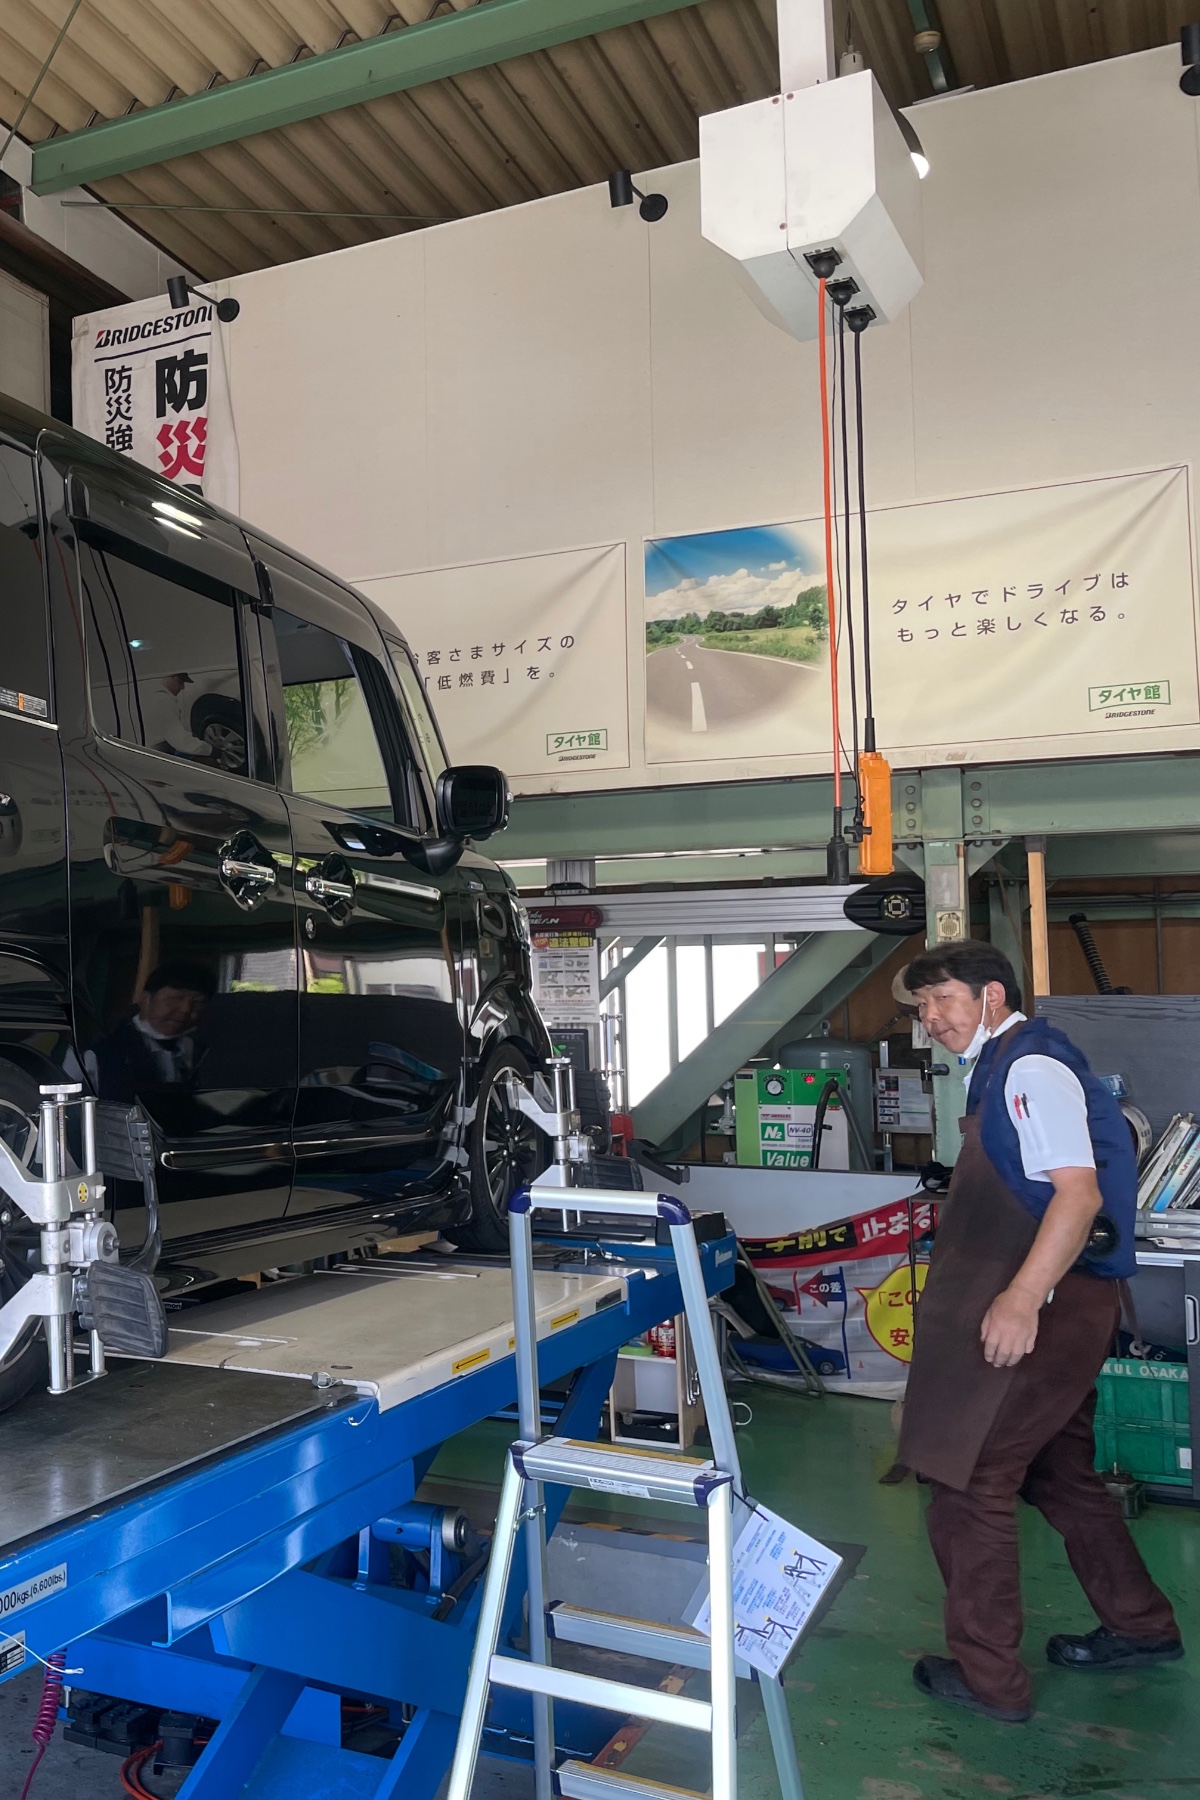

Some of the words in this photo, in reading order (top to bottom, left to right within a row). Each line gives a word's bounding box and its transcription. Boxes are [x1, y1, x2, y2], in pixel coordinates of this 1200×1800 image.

[94, 304, 213, 349] BRIDGESTON
[891, 571, 1130, 615] タイヤでドライブは
[896, 604, 1127, 643] もっと楽しくなる。
[424, 664, 555, 691] 「低燃費」を。
[1097, 684, 1161, 704] タイヤ館
[1104, 708, 1156, 719] BRIDGESTONE
[553, 731, 601, 749] タイヤ館
[558, 752, 597, 762] BRIDGESTONE
[789, 1126, 811, 1134] NV-40
[766, 1151, 810, 1168] Value
[861, 1203, 936, 1243] 止まる
[808, 1281, 842, 1294] この差
[1139, 1365, 1189, 1380] OSAKA
